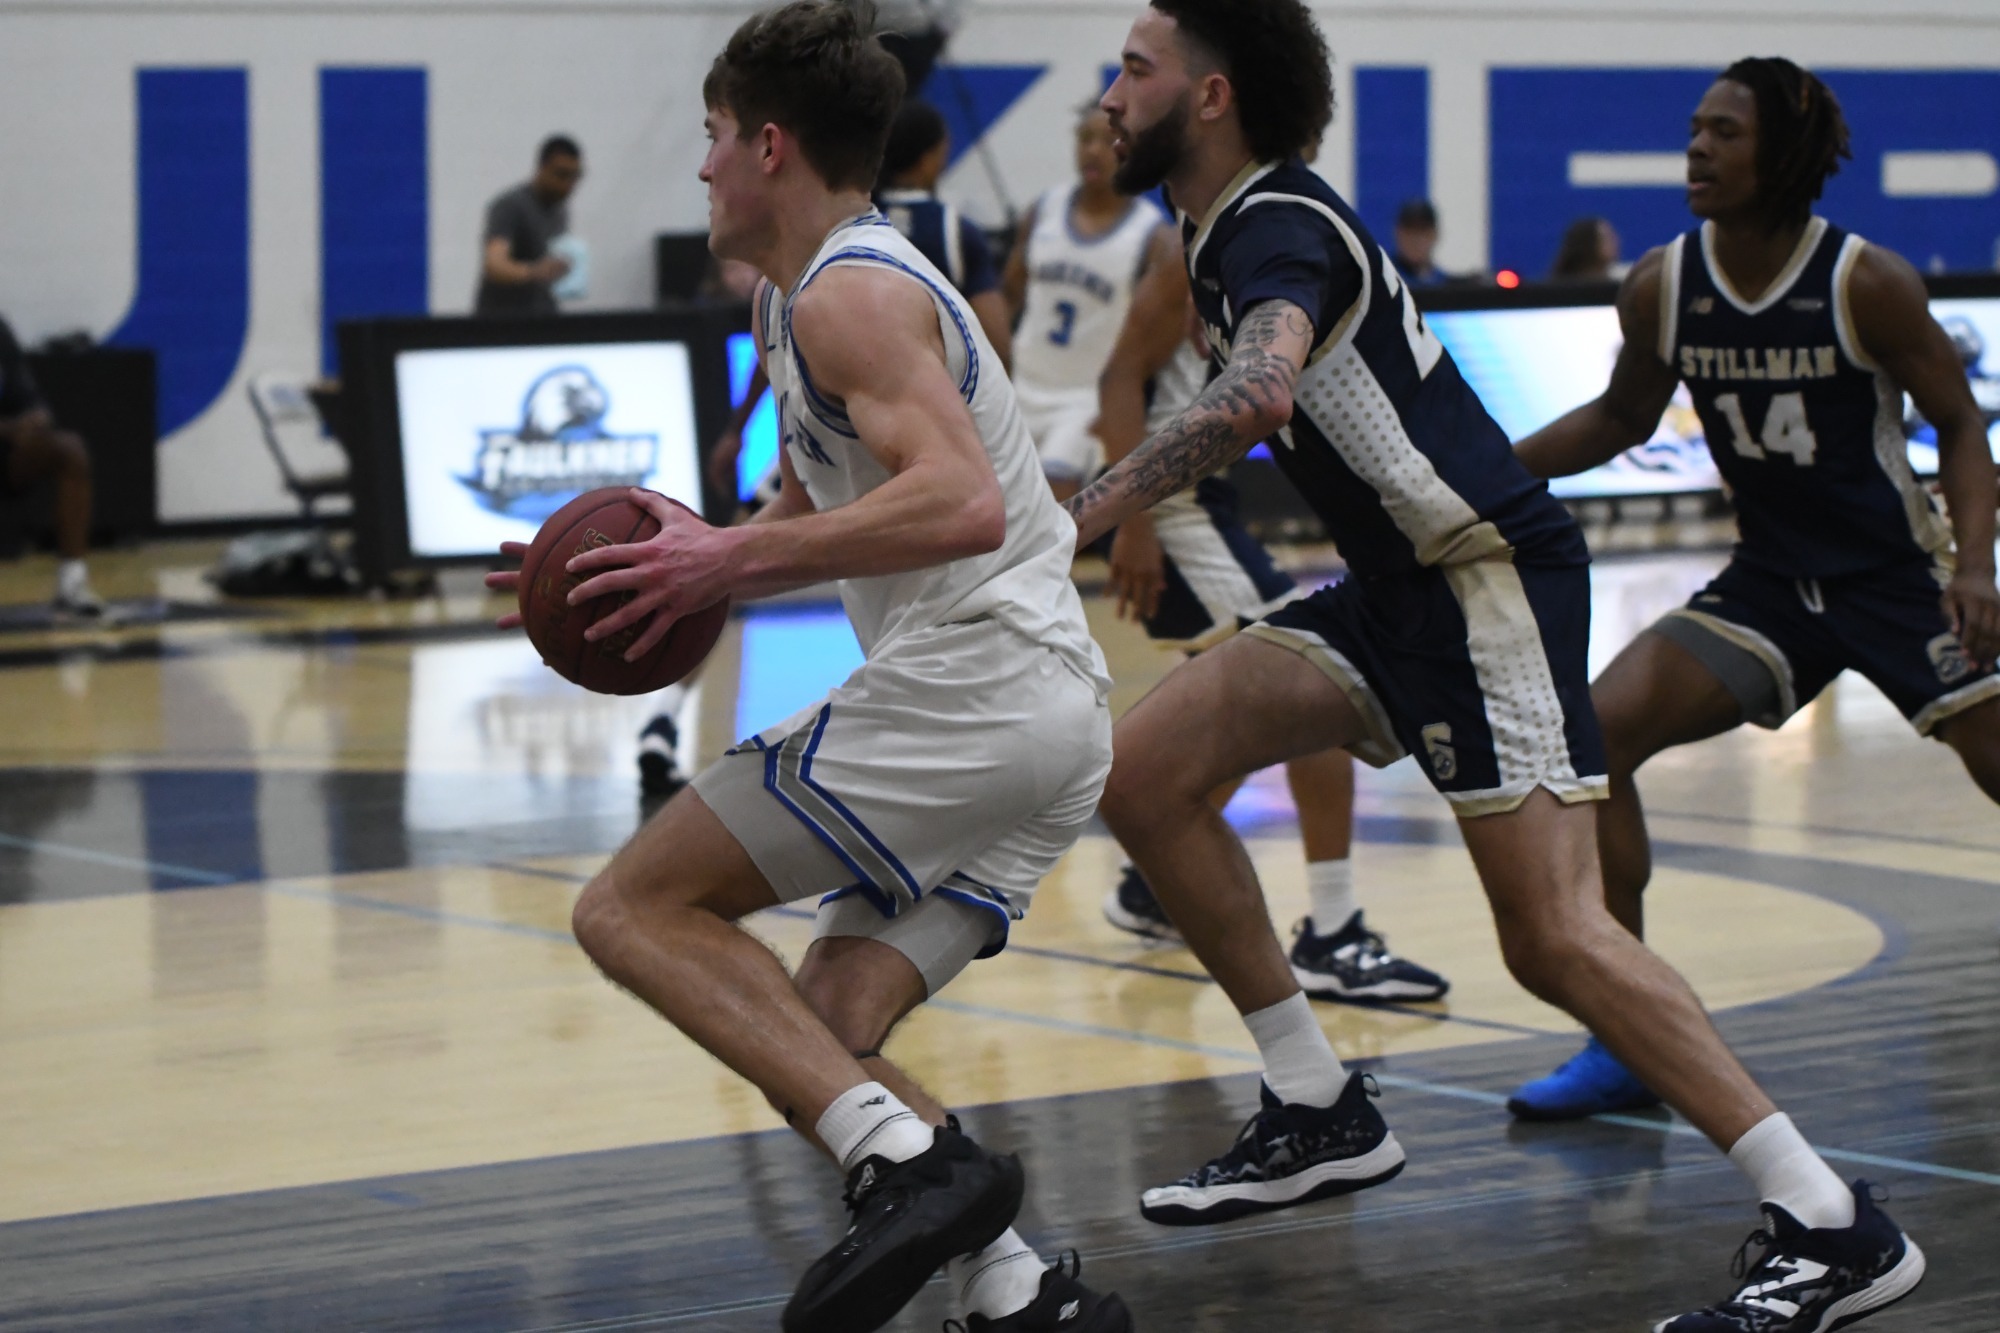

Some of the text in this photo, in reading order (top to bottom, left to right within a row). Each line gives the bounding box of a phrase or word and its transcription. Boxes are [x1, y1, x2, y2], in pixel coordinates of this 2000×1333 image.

[1048, 301, 1076, 347] 3
[1680, 346, 1836, 380] STILLMAN
[1713, 391, 1817, 466] 14
